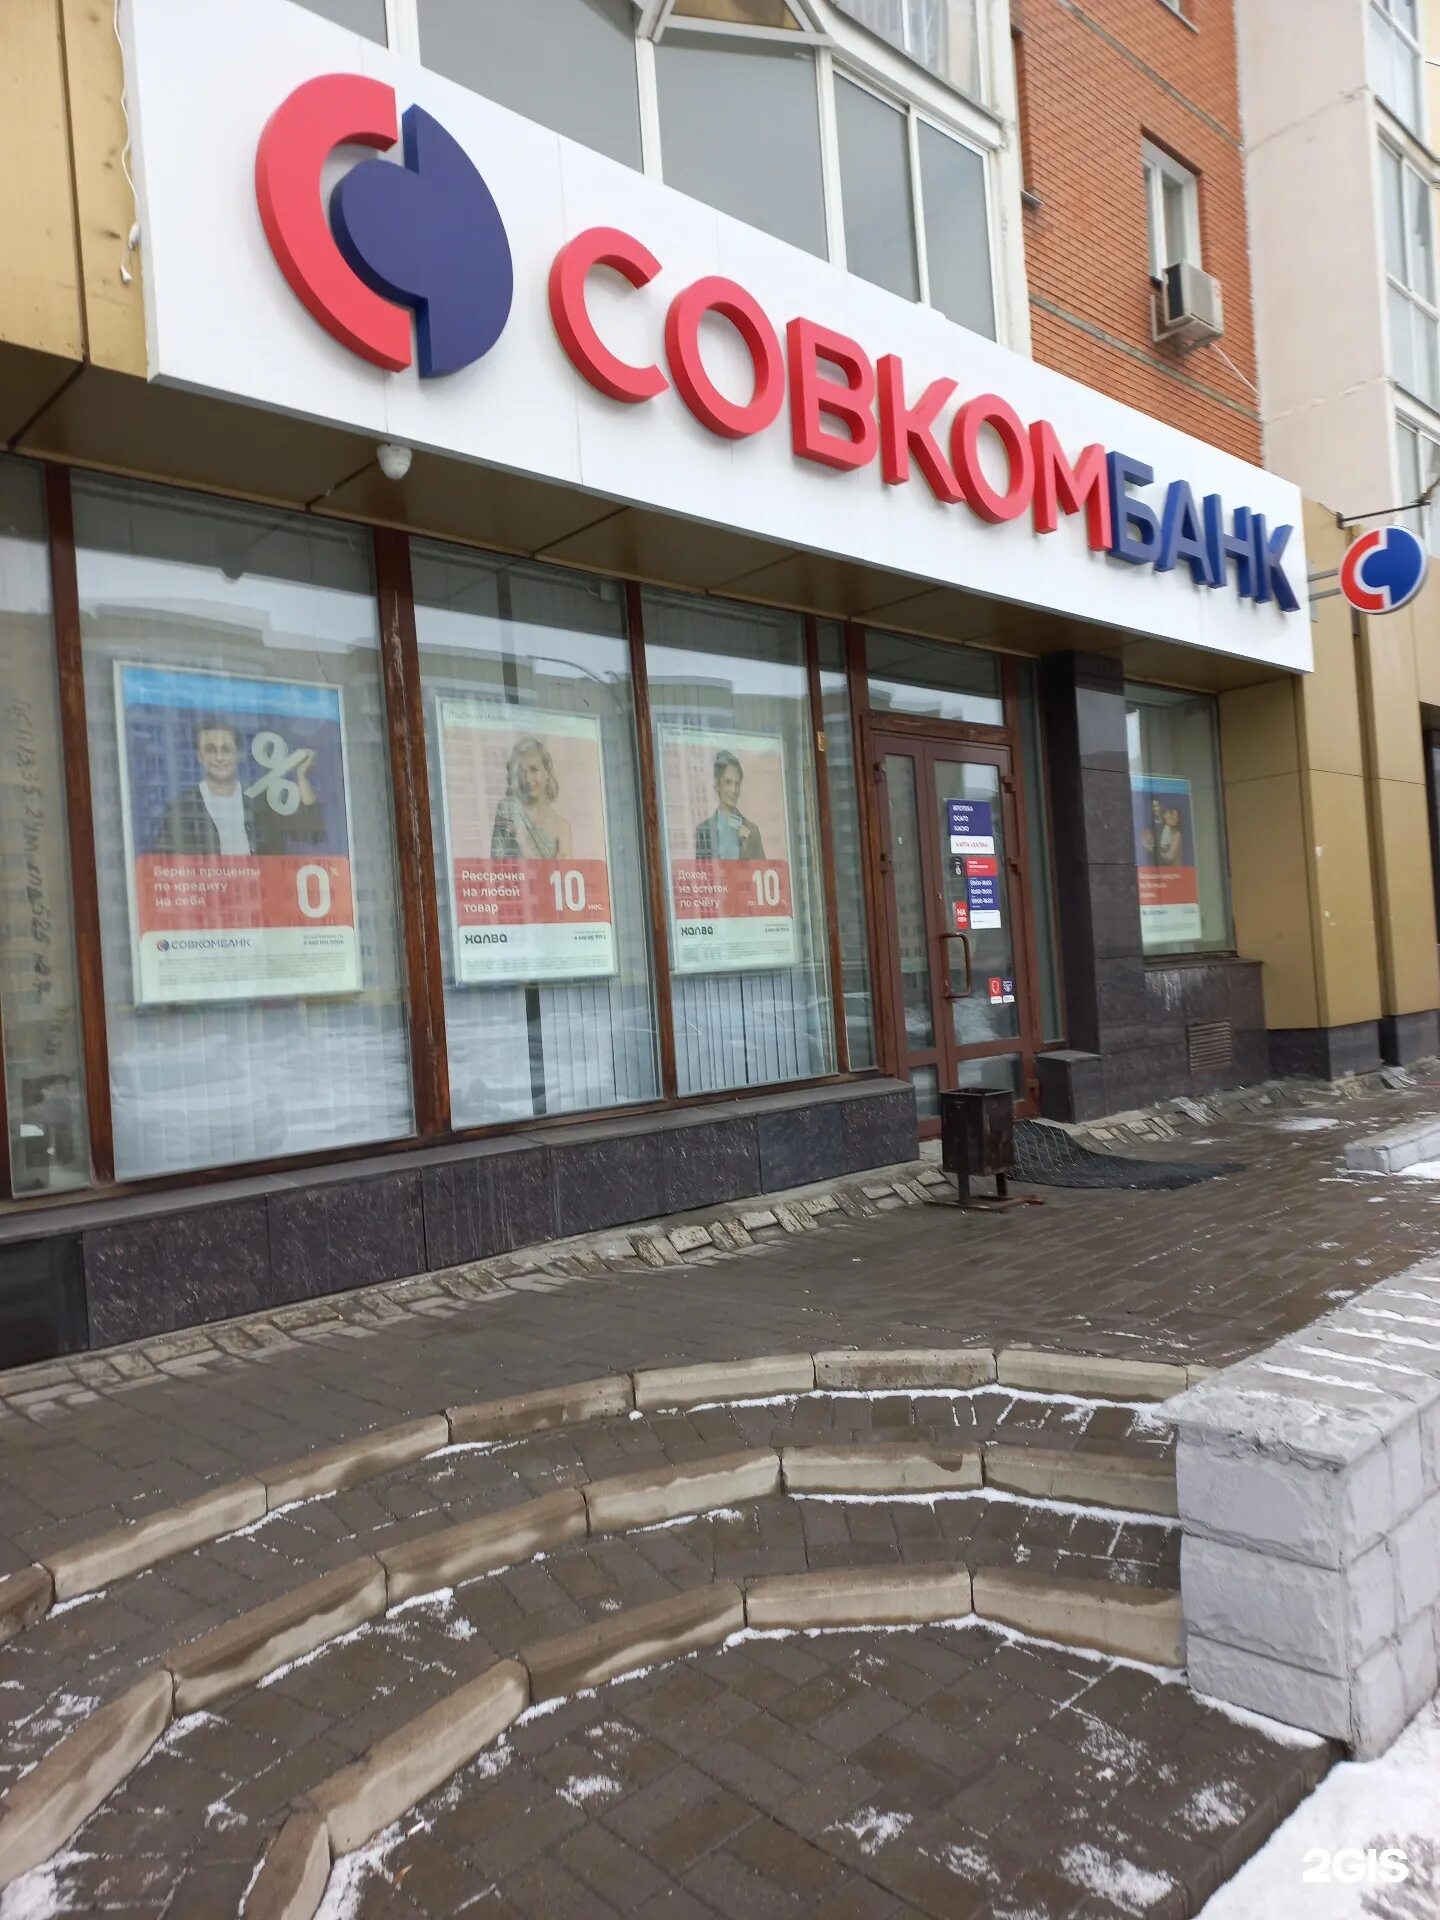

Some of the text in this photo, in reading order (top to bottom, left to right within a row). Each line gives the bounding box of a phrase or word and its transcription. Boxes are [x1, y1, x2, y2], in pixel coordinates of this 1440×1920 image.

[547, 225, 1300, 613] СОВКОМБАНК
[199, 867, 261, 881] проценты
[462, 870, 526, 884] Рассрочка
[677, 869, 708, 881] Доход
[154, 881, 228, 894] по кредиту
[463, 885, 520, 897] на любой
[549, 870, 586, 911] 10
[679, 885, 729, 894] на остаток
[155, 895, 206, 907] на себя
[680, 900, 692, 908] по
[464, 903, 499, 915] товар
[957, 908, 966, 916] НА
[171, 937, 253, 952] СОВКОМБАНК
